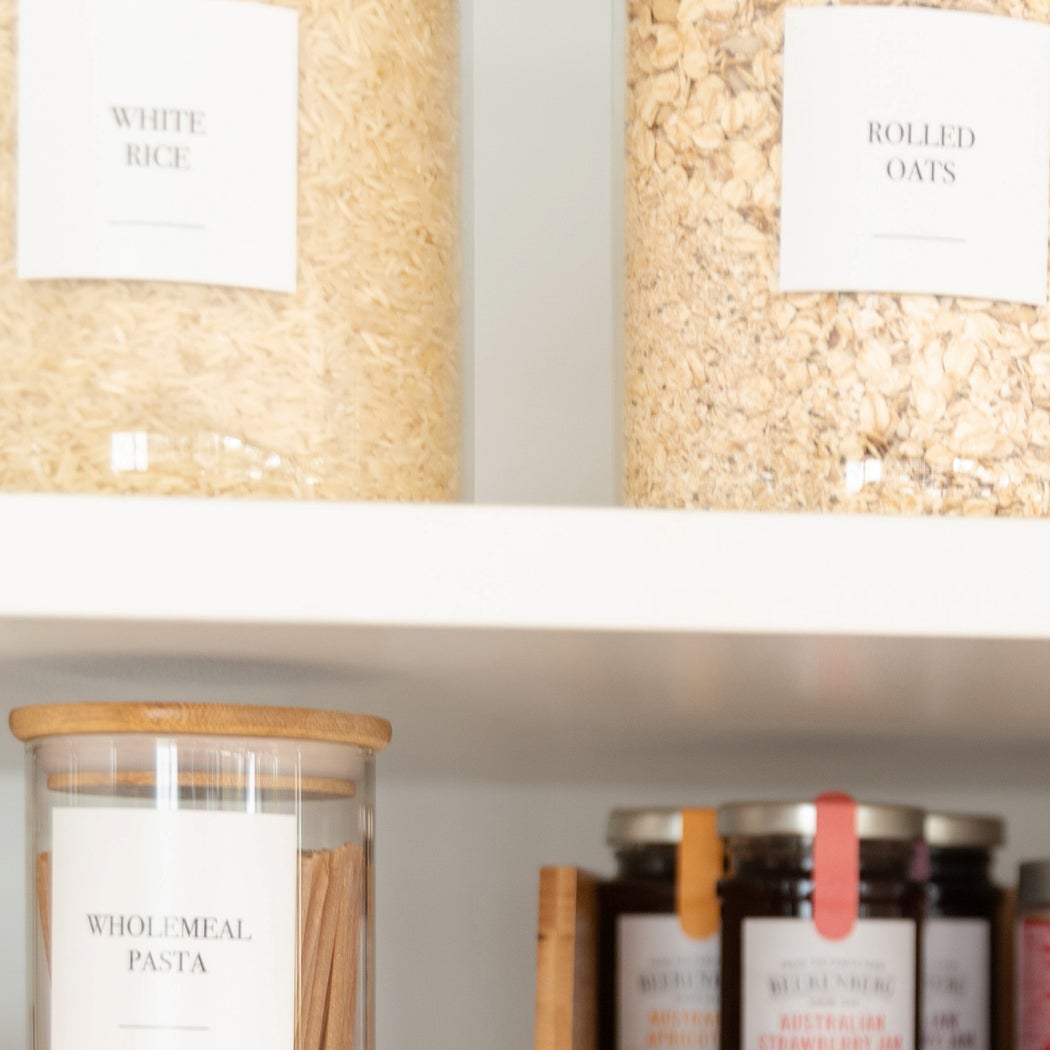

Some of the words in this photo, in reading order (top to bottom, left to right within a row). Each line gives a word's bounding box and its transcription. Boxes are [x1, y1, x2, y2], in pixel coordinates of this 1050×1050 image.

[111, 106, 206, 136] WHITE
[867, 120, 976, 150] ROLLED
[125, 142, 191, 171] RICE
[886, 157, 957, 185] OATS
[87, 913, 252, 942] WHOLEMEAL
[128, 949, 208, 973] PASTA
